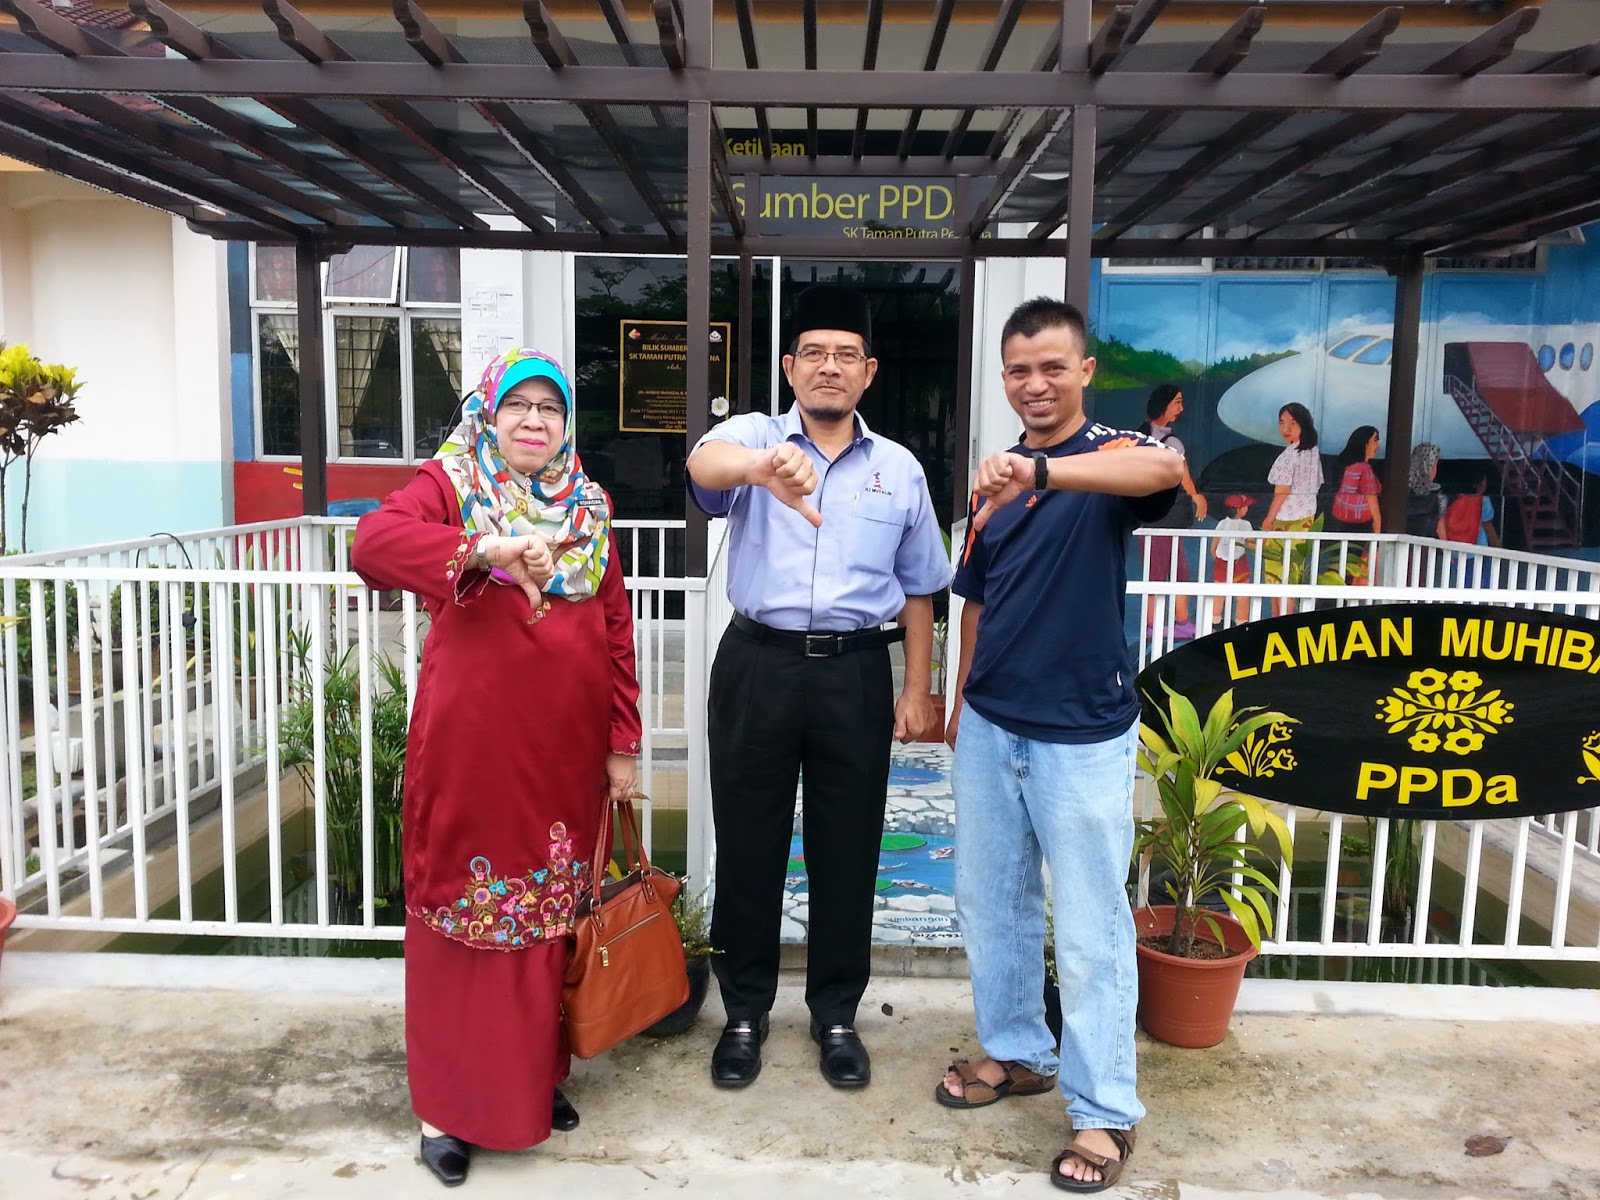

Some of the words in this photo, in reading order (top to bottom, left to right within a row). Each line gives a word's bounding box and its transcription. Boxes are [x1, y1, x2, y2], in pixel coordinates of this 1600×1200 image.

[879, 184, 955, 220] PPD
[843, 226, 859, 238] SK
[860, 226, 902, 238] Taman
[905, 227, 938, 238] Putra
[1224, 616, 1413, 681] LAMAN
[1440, 616, 1600, 675] MUHIB
[1355, 761, 1519, 808] PPDa
